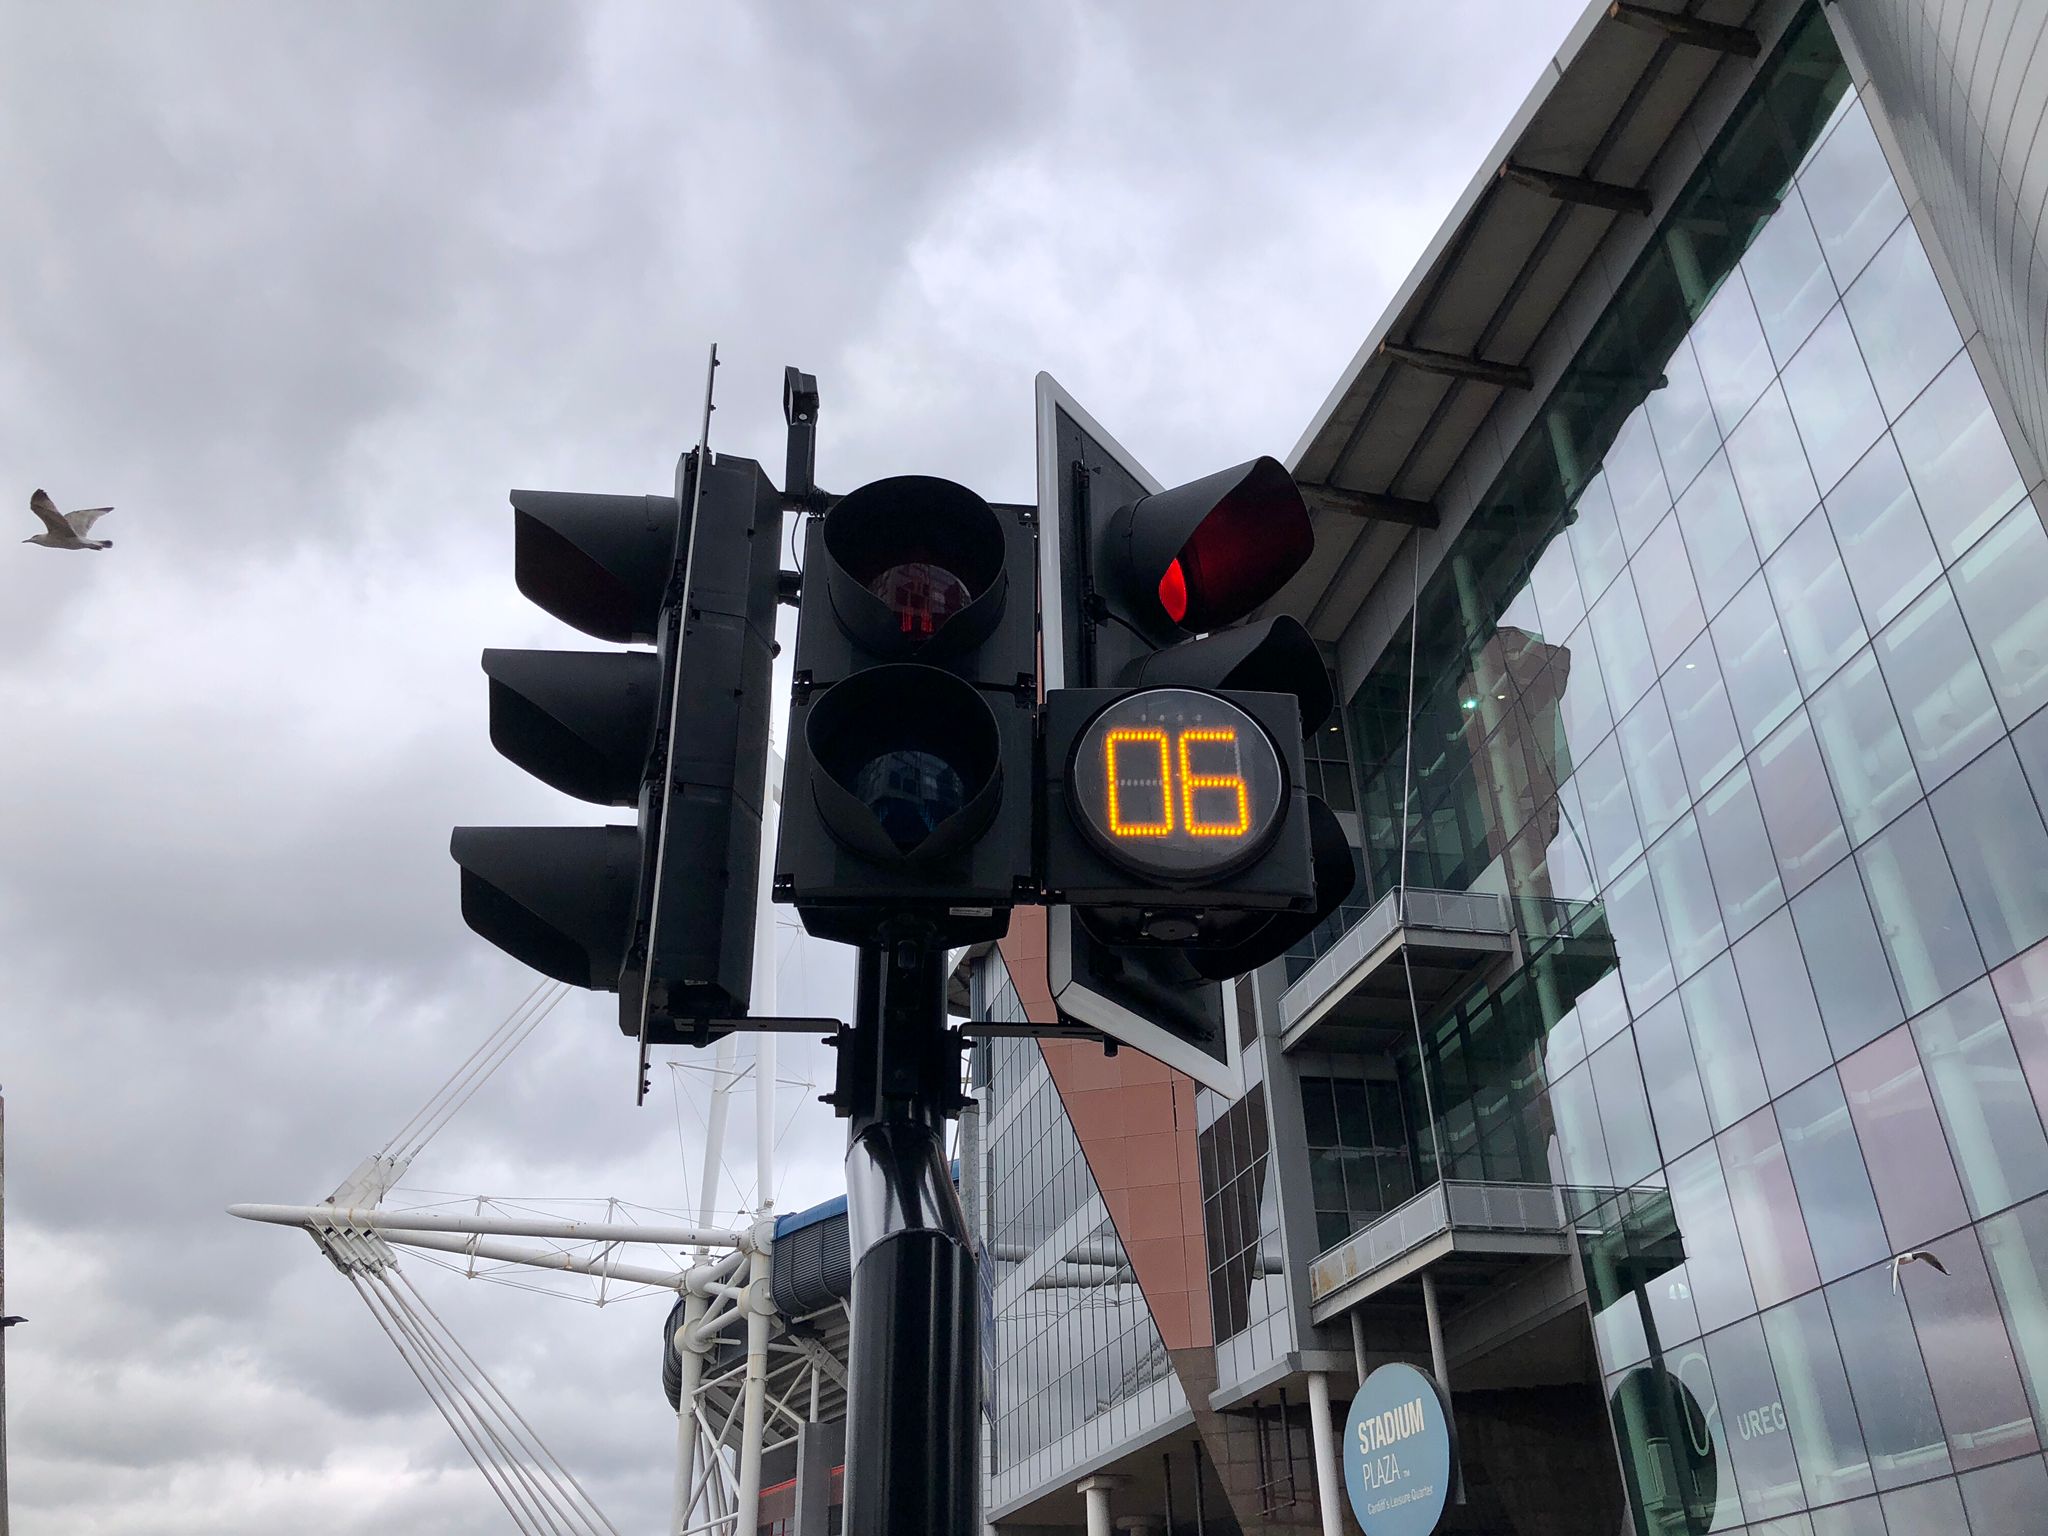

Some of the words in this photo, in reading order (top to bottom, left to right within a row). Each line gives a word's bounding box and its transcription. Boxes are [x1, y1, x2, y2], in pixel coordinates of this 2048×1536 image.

[1106, 726, 1249, 838] 06
[1358, 1398, 1425, 1455] STADIUM
[1362, 1453, 1401, 1492] PLAZA
[1367, 1498, 1390, 1516] Cardiff's
[1390, 1493, 1411, 1508] Leisure
[1411, 1485, 1433, 1501] Quarter
